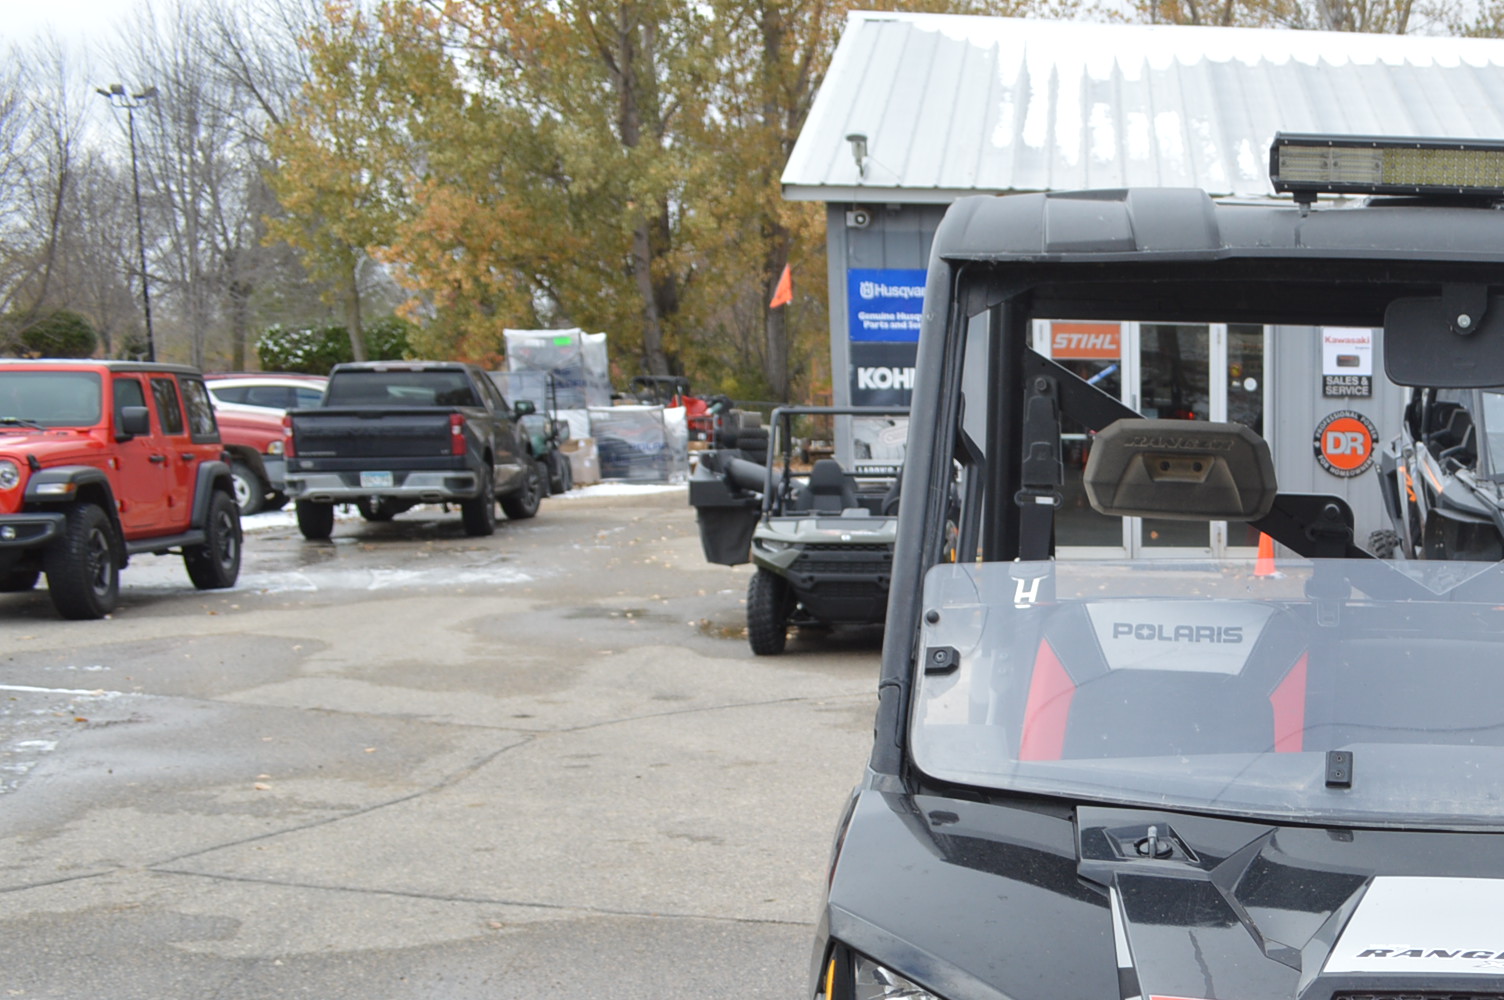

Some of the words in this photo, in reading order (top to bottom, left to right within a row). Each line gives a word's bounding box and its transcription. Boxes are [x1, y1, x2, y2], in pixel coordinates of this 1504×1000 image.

[1053, 333, 1117, 349] STIHL
[1324, 336, 1370, 344] Kawasaki
[1326, 376, 1358, 386] SALES
[1361, 376, 1369, 386] &
[1325, 385, 1369, 395] SERVICE
[1326, 431, 1364, 455] DR
[1112, 622, 1244, 645] POLARIS
